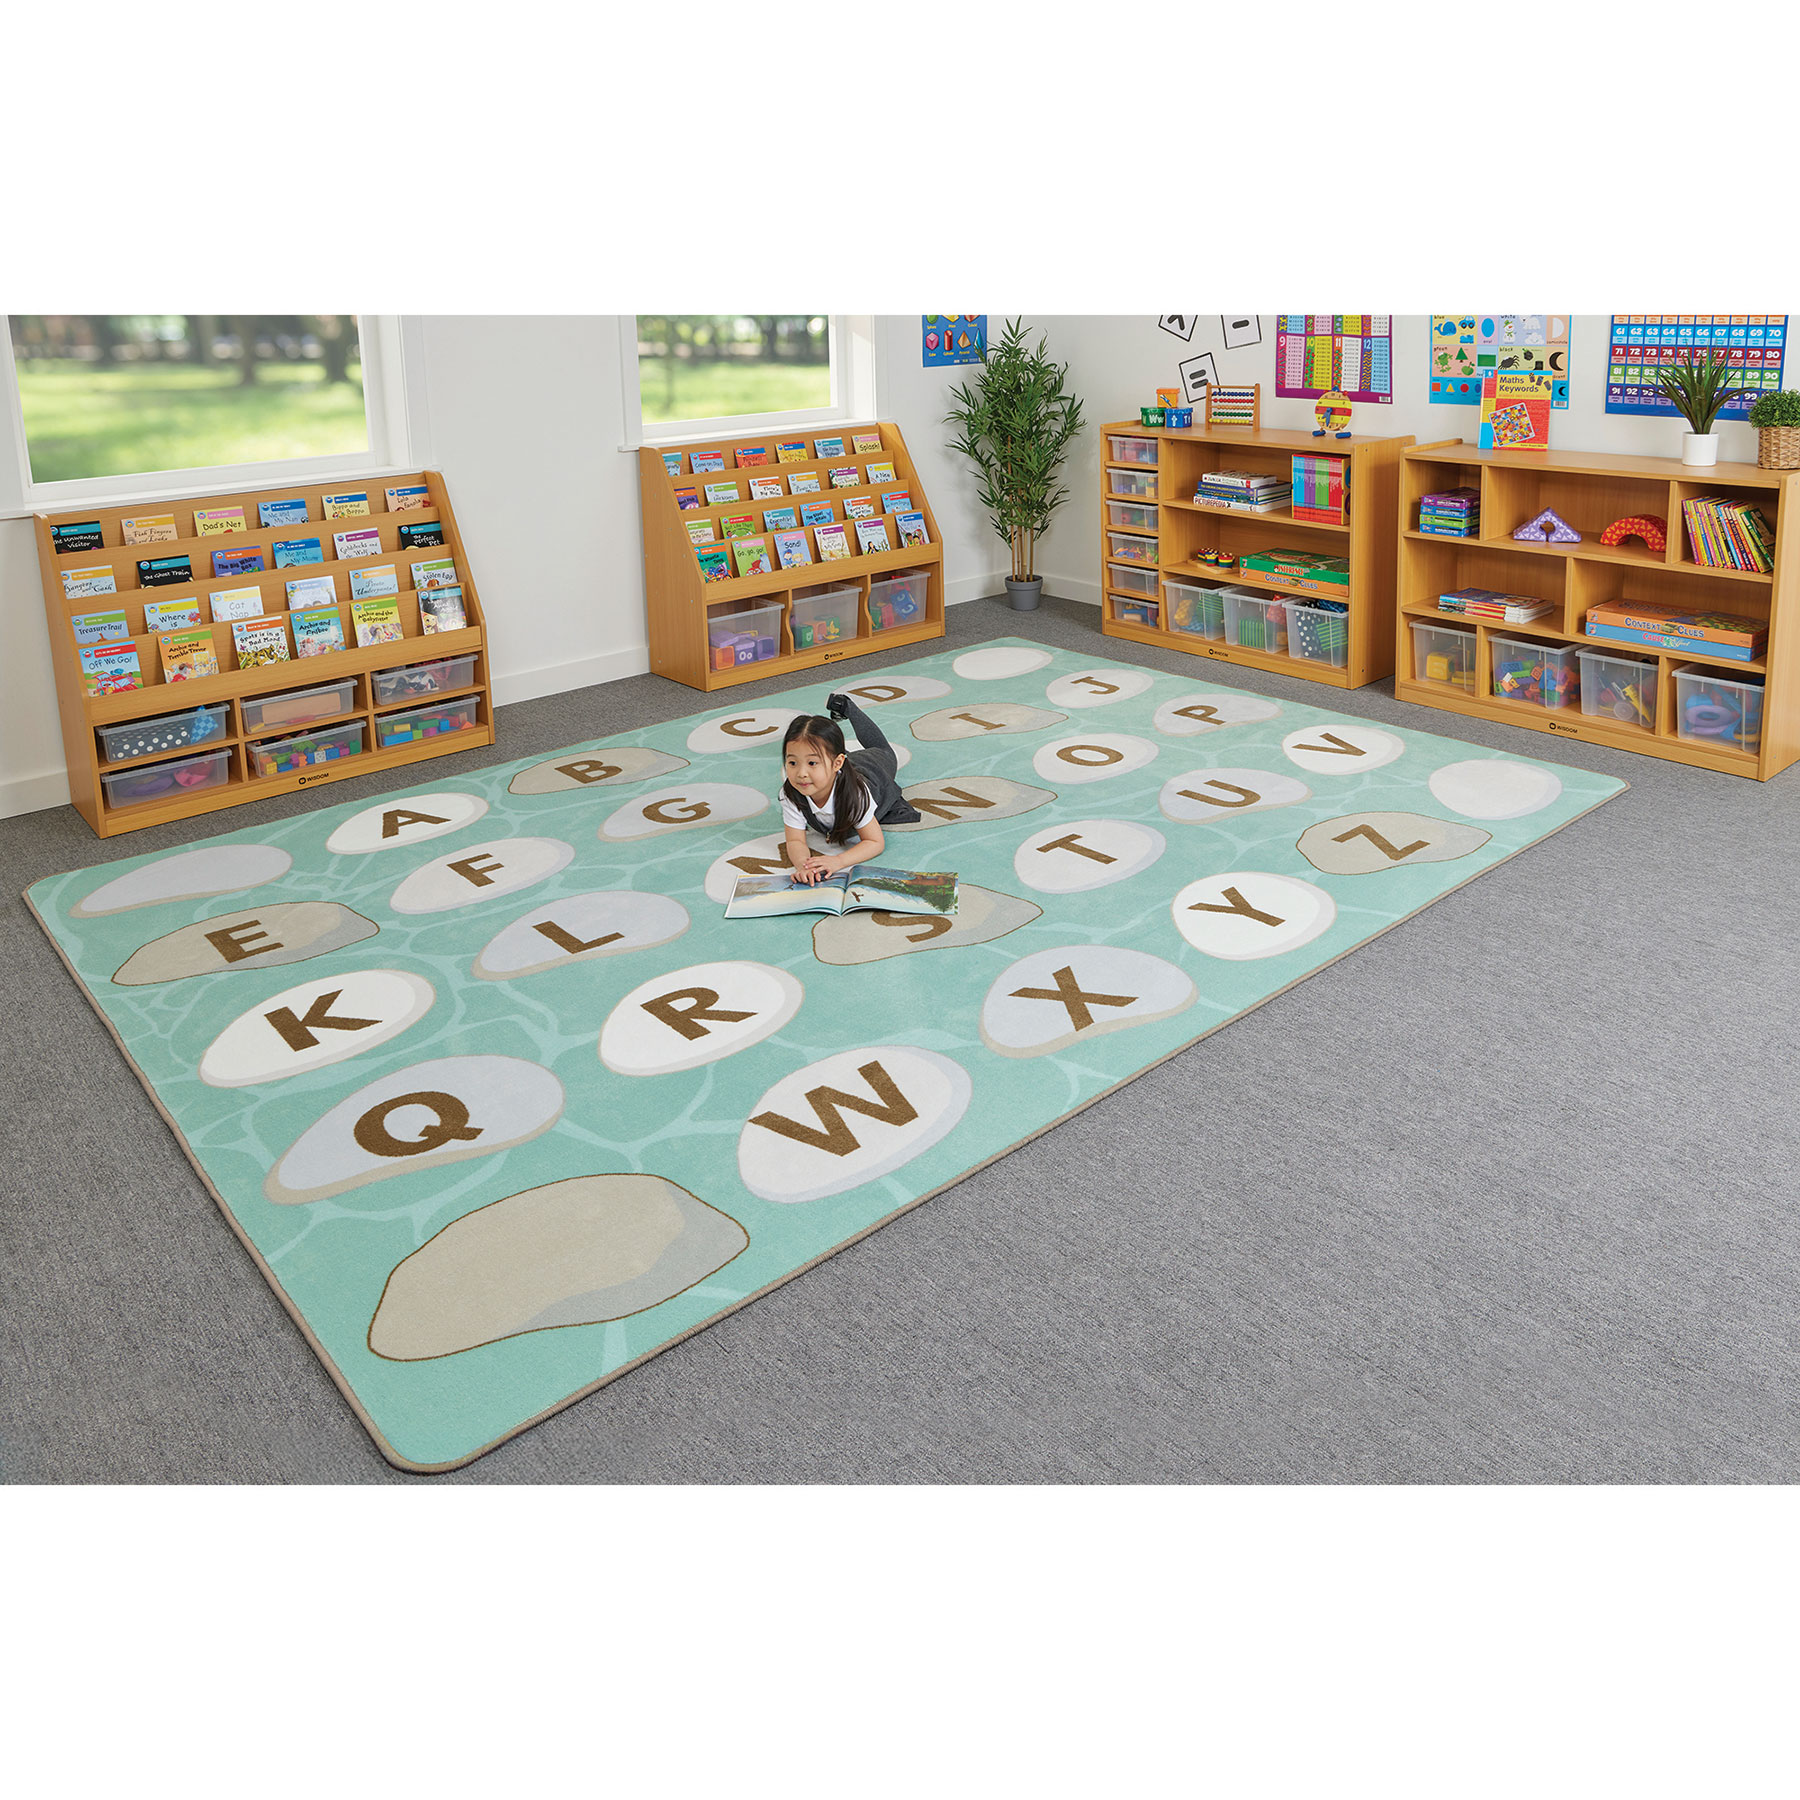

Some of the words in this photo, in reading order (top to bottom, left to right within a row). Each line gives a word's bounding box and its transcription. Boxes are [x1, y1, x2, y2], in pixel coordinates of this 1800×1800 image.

[1280, 336, 1286, 346] 9
[1306, 338, 1314, 346] 10
[1336, 338, 1342, 347] 11
[1364, 338, 1372, 350] 12
[1500, 385, 1540, 394] Keywords
[202, 522, 224, 531] Dad's
[64, 534, 99, 542] Unwanted
[239, 556, 257, 564] White
[241, 563, 252, 571] Box
[1278, 565, 1304, 576] INFERENCE
[1265, 574, 1289, 584] CONTEXT
[1300, 580, 1318, 590] CLUES
[229, 602, 246, 610] Cat
[158, 614, 186, 624] Where
[1624, 616, 1661, 631] CONTEXT
[1677, 624, 1704, 638] CLUES
[78, 625, 108, 636] Treasure
[1642, 632, 1665, 644] CAUSE
[88, 659, 102, 670] Off
[116, 656, 132, 664] Go!
[847, 685, 908, 703] D
[1072, 676, 1119, 695] J
[949, 712, 1006, 731] I
[1173, 705, 1225, 726] P
[719, 717, 779, 737] C
[1292, 732, 1367, 757] V
[1056, 744, 1124, 767] O
[307, 773, 329, 782] WISDOM
[554, 759, 623, 785] B
[1177, 779, 1261, 808] U
[642, 797, 712, 825] G
[909, 786, 997, 822] N
[382, 808, 451, 840] A
[1037, 833, 1118, 865] T
[1332, 823, 1431, 861] Z
[447, 853, 505, 888] F
[1188, 886, 1286, 927] Y
[532, 919, 625, 955] L
[870, 911, 953, 944] S
[204, 919, 285, 964] E
[1008, 965, 1137, 1032] X
[263, 989, 382, 1053] K
[639, 987, 758, 1041] R
[747, 1060, 919, 1157] W
[353, 1091, 484, 1158] Q
